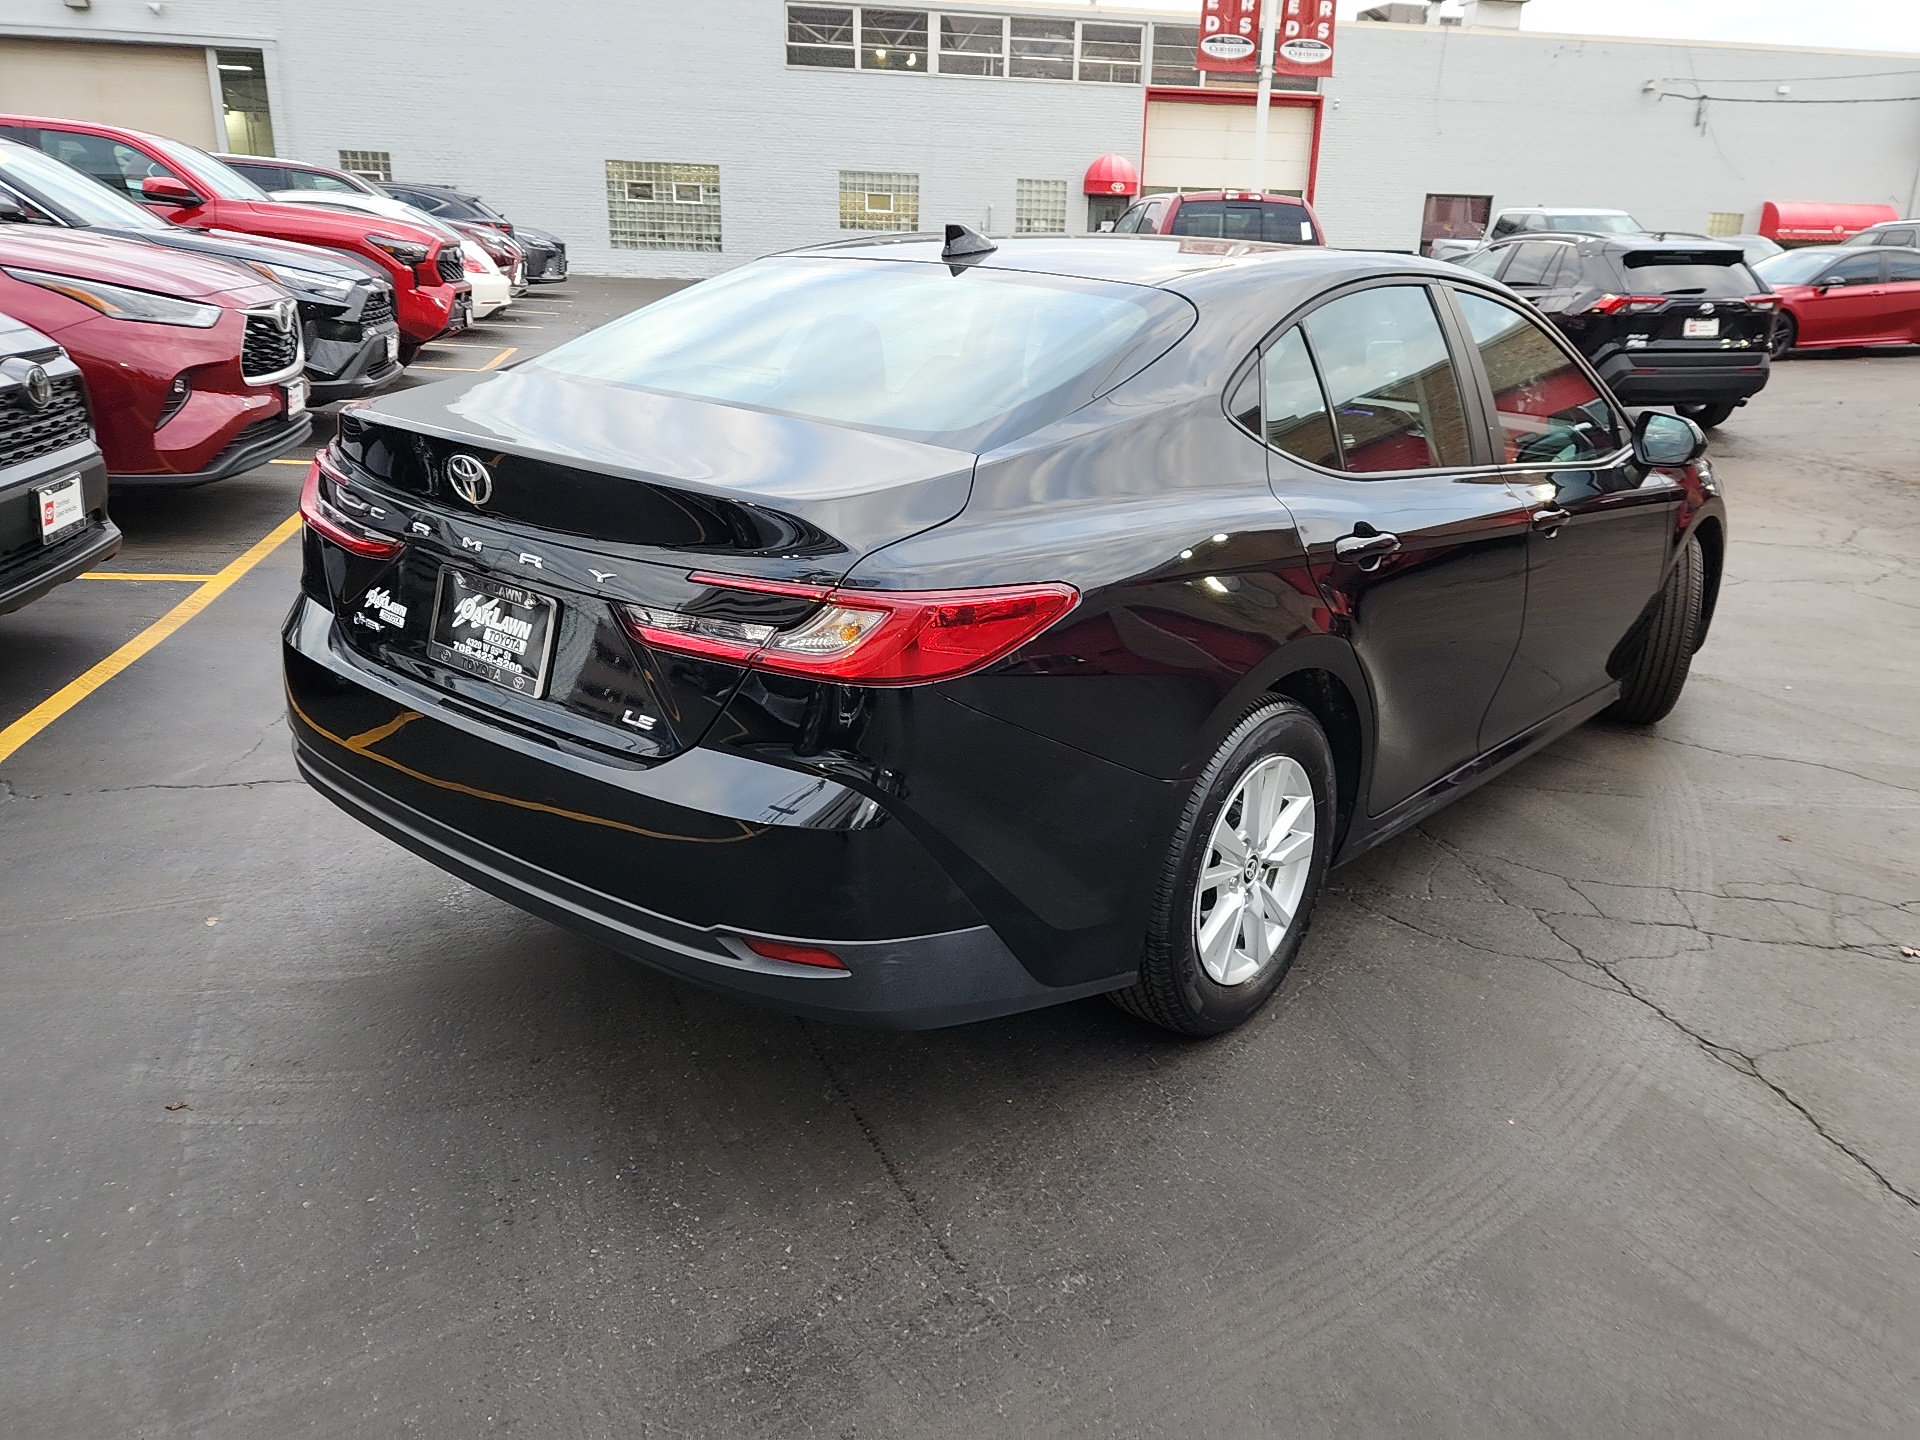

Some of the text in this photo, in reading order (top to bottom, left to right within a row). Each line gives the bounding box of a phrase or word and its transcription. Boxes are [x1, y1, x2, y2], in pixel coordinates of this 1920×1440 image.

[465, 638, 483, 649] 4320
[483, 643, 490, 652] W
[489, 630, 522, 651] TOYOTA
[453, 641, 523, 674] 708-423-5200
[461, 655, 502, 682] TOYOTA
[621, 709, 658, 731] LE
